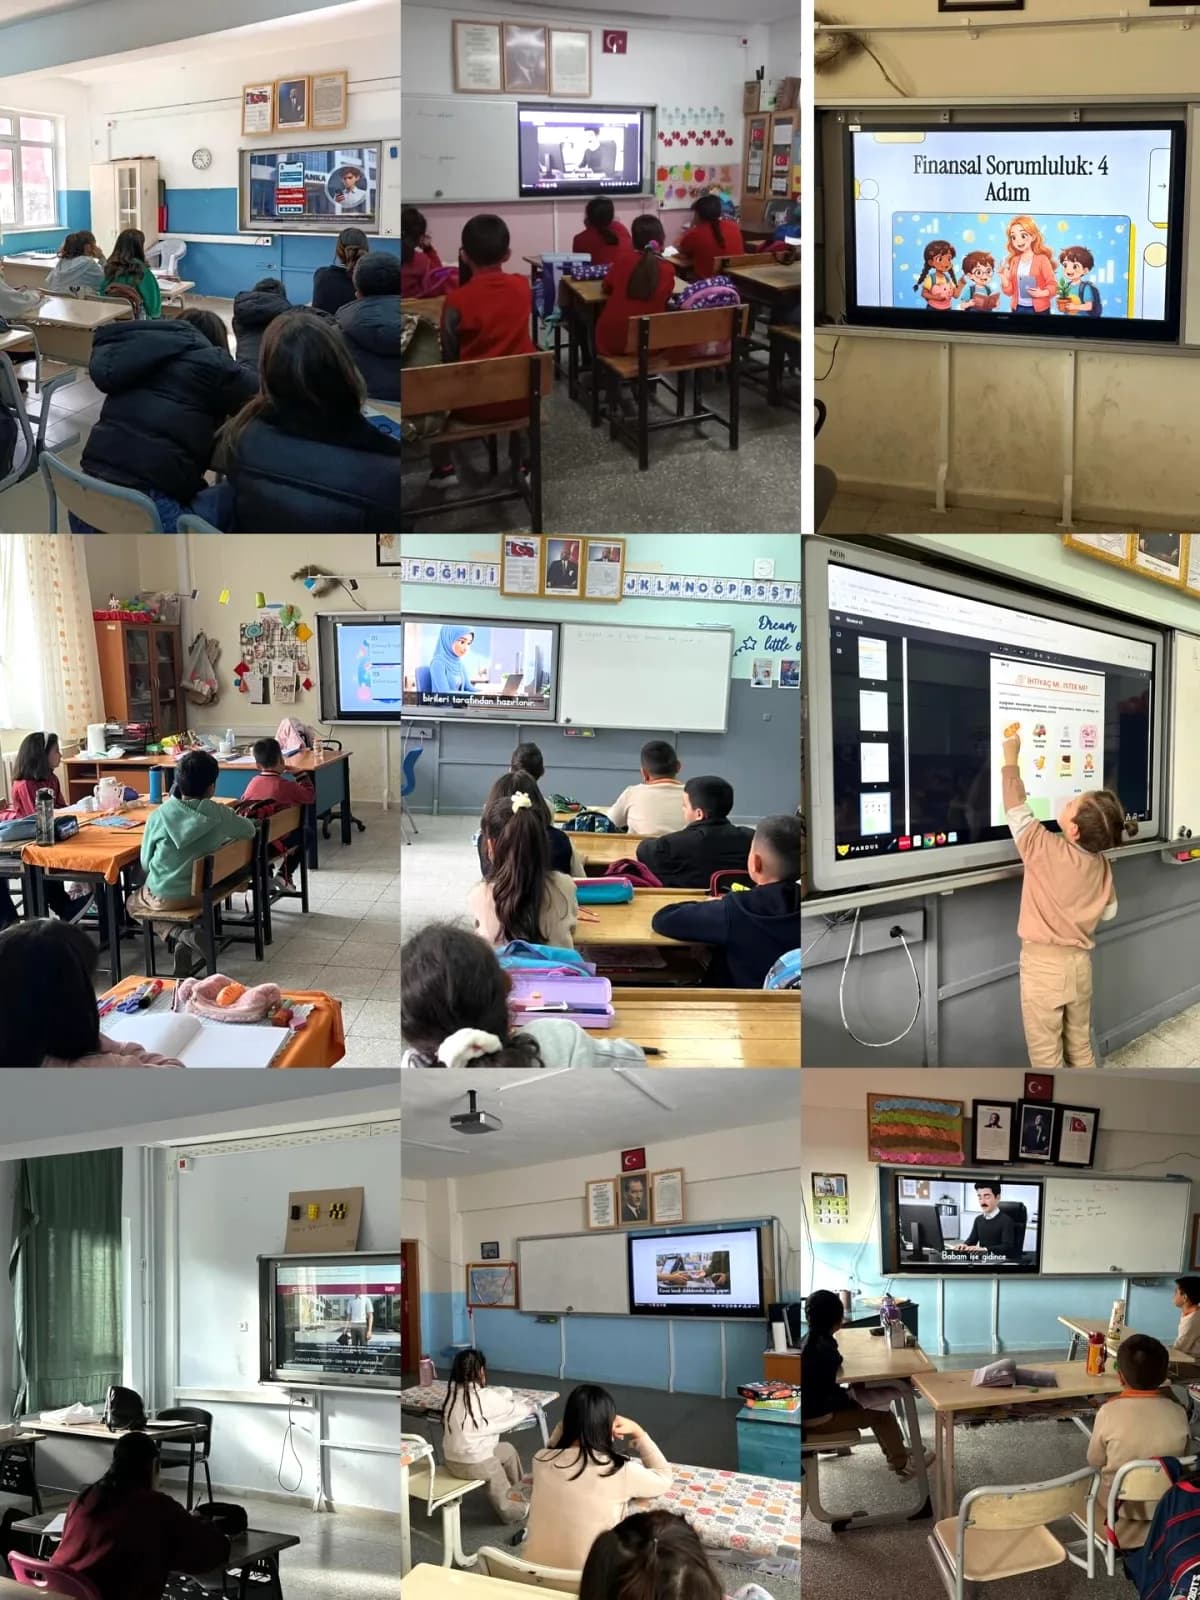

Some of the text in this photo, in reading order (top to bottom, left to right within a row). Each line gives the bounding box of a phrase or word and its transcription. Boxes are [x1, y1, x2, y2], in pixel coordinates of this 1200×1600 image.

[913, 154, 1109, 175] Finansal Sorumluluk: 4
[985, 182, 1030, 201] Adım
[413, 566, 420, 576] F
[426, 566, 434, 577] G
[442, 565, 451, 578] Ğ
[457, 568, 466, 579] H
[490, 568, 494, 582] İ
[627, 580, 792, 599] J K L M N O Ö P R S Ş T
[758, 615, 797, 633] Dream
[764, 635, 792, 651] little
[423, 693, 449, 703] birileri
[851, 844, 878, 852] PARDUS
[942, 1250, 1006, 1263] Babam işe gidince
